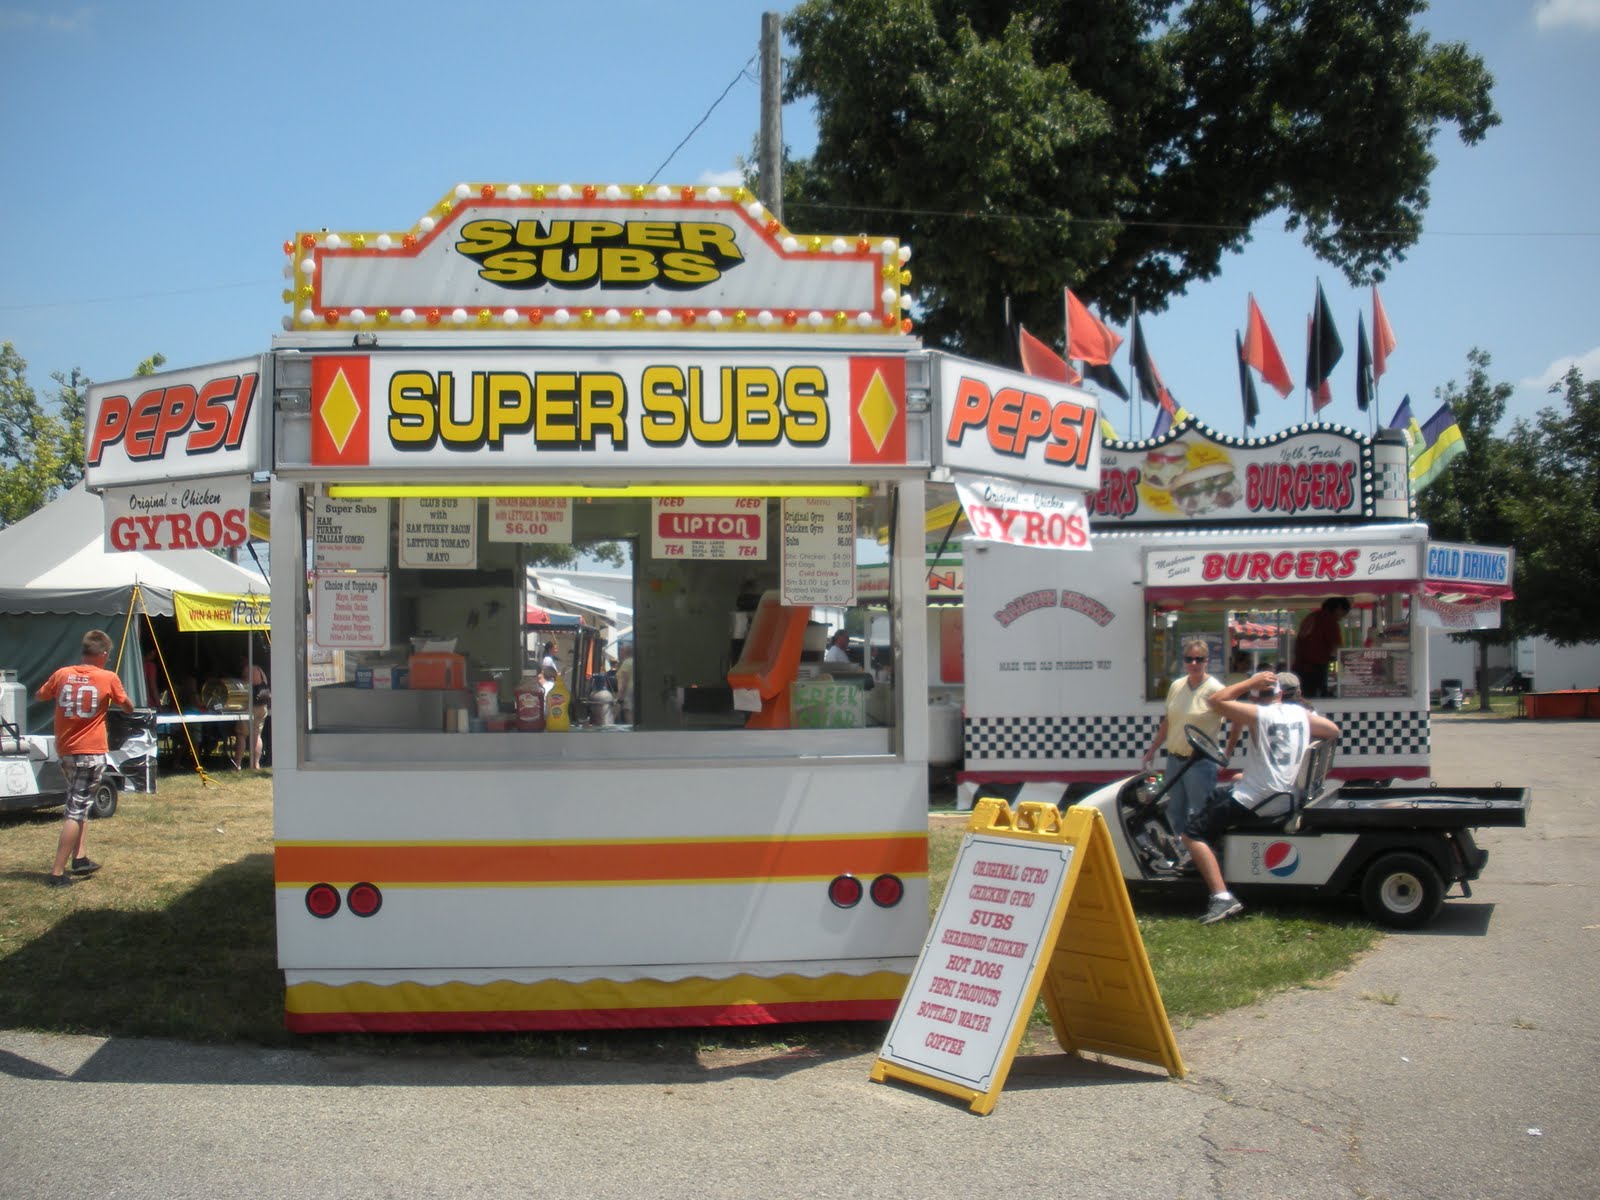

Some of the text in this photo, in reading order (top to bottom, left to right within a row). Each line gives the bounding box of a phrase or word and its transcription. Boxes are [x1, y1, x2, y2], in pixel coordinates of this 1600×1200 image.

[456, 218, 744, 262] SUPER
[479, 247, 725, 289] SUBS
[388, 366, 830, 451] SUPER SUBS
[88, 373, 259, 467] PEPSI
[947, 376, 1096, 471] PEPSI
[1308, 445, 1342, 460] Fresh
[1246, 461, 1357, 515] BURGERS
[129, 494, 168, 513] Original
[180, 489, 222, 509] Chicken
[325, 504, 377, 515] Super Subs
[420, 498, 458, 508] CLUB SUB
[659, 496, 761, 508] ICED ICED
[1034, 492, 1065, 510] Chicken
[316, 517, 333, 526] HAM
[429, 510, 448, 520] with
[508, 510, 533, 521] LETTUCE
[541, 511, 563, 522] TOMATO
[784, 511, 809, 524] Original
[810, 511, 825, 524] Gyro
[110, 509, 248, 551] GYROS
[316, 526, 343, 535] TURKEY
[423, 524, 449, 534] TURKEY
[450, 524, 471, 534] BACON
[505, 522, 548, 535] $6.00
[673, 516, 750, 539] LIPTON
[785, 523, 809, 534] Chicken
[809, 524, 824, 536] Gyro
[968, 504, 1087, 547] GYROS
[316, 535, 365, 544] ITALIAN COMBO
[407, 538, 471, 549] LETTUCE TOMATO
[786, 537, 800, 547] Subs
[426, 552, 450, 562] MAYO
[665, 544, 684, 556] TEA
[738, 546, 758, 557] TEA
[1369, 550, 1398, 562] Bacon
[798, 561, 816, 569] Dogs
[1155, 555, 1196, 570] Mushroom
[1201, 549, 1361, 582] BURGERS
[1368, 558, 1406, 575] Cheddar
[1428, 547, 1507, 583] COLD DRINKS
[1168, 567, 1191, 578] Swiss
[324, 580, 343, 591] Choice
[344, 580, 351, 591] of
[352, 580, 378, 593] Toppings
[793, 594, 815, 602] Coffee
[189, 609, 205, 621] WIN
[205, 609, 212, 620] A
[213, 609, 232, 620] NEW
[232, 599, 264, 625] iPad
[58, 684, 98, 718] 40
[1250, 842, 1262, 876] pepsi
[973, 860, 1048, 885] ORIGINAL GYRO
[968, 884, 1036, 908] CHICKEN GYRO
[969, 910, 1015, 931] SUBS
[941, 928, 1029, 959] SHREDDED CHICKEN
[945, 954, 1004, 980] HOT DOGS
[928, 976, 1002, 1008] PEPSI PRODUCTS
[916, 1001, 992, 1032] BOTTLED WATER
[924, 1031, 966, 1056] COFFEE
